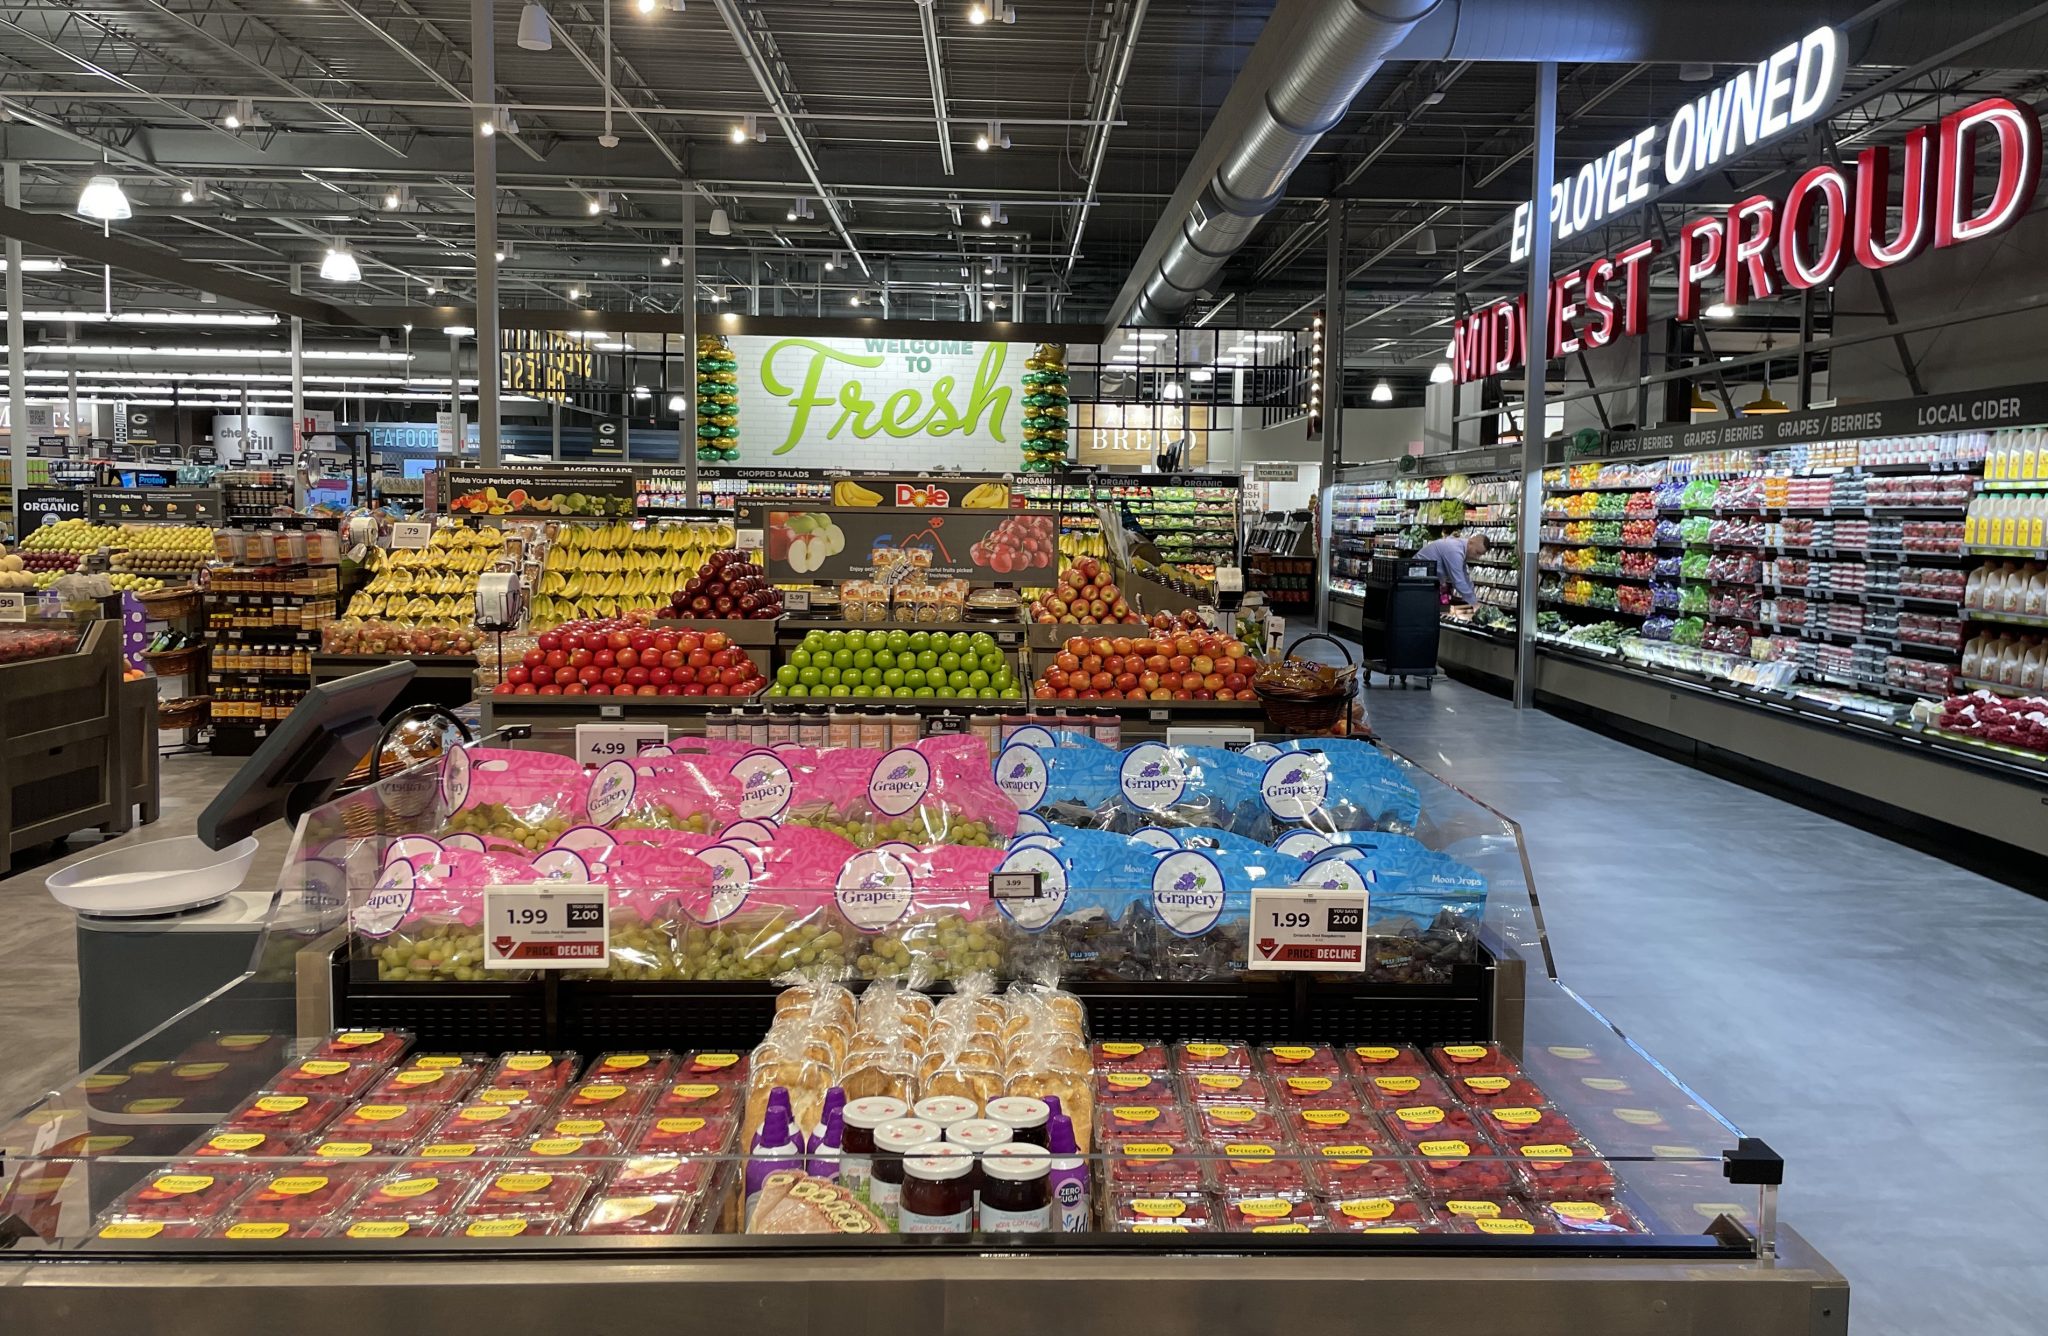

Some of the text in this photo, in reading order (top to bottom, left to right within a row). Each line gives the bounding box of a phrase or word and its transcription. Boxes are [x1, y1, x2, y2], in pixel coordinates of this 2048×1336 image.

[1510, 26, 1840, 264] EPLOYEE OWNED
[1677, 98, 2043, 322] PROUD
[864, 338, 974, 355] WELCOME
[905, 356, 931, 373] TO
[761, 337, 1013, 455] Fresh
[1918, 398, 2021, 425] LOCAL CIDER
[1777, 418, 1820, 438] GRAPES
[1831, 411, 1882, 433] BERRIES
[1684, 430, 1717, 447] GRAPES
[1725, 424, 1764, 443] BERRIES
[1610, 438, 1637, 453] GRAPES
[1643, 435, 1674, 451] BERRIES
[451, 476, 471, 484] Make
[472, 476, 488, 484] Your
[489, 477, 515, 485] Perfect
[737, 470, 776, 478] CHOPPED
[897, 485, 949, 506] Dole
[22, 502, 79, 512] ORGANIC
[404, 527, 419, 535] .79
[591, 743, 626, 755] 4.99
[873, 779, 923, 793] Grapery
[1000, 777, 1042, 793] Grapery
[1125, 777, 1180, 792] Grapery
[1267, 785, 1322, 798] Grapery
[590, 788, 630, 812] Grapery
[743, 783, 787, 802] rapery
[656, 865, 705, 874] Cotton Candy
[1124, 863, 1144, 874] Moon
[1432, 874, 1455, 884] Moon
[368, 893, 407, 908] apery
[842, 890, 905, 904] Grapery
[1158, 892, 1218, 908] Grapery
[507, 909, 548, 924] 1.99
[572, 910, 599, 920] 2.00
[1272, 912, 1310, 928] 1.99
[1332, 915, 1358, 924] 2.00
[525, 945, 600, 956] PRICE DECLINE
[1287, 948, 1357, 959] PRICE DECLINE
[1060, 1186, 1081, 1195] ZERO
